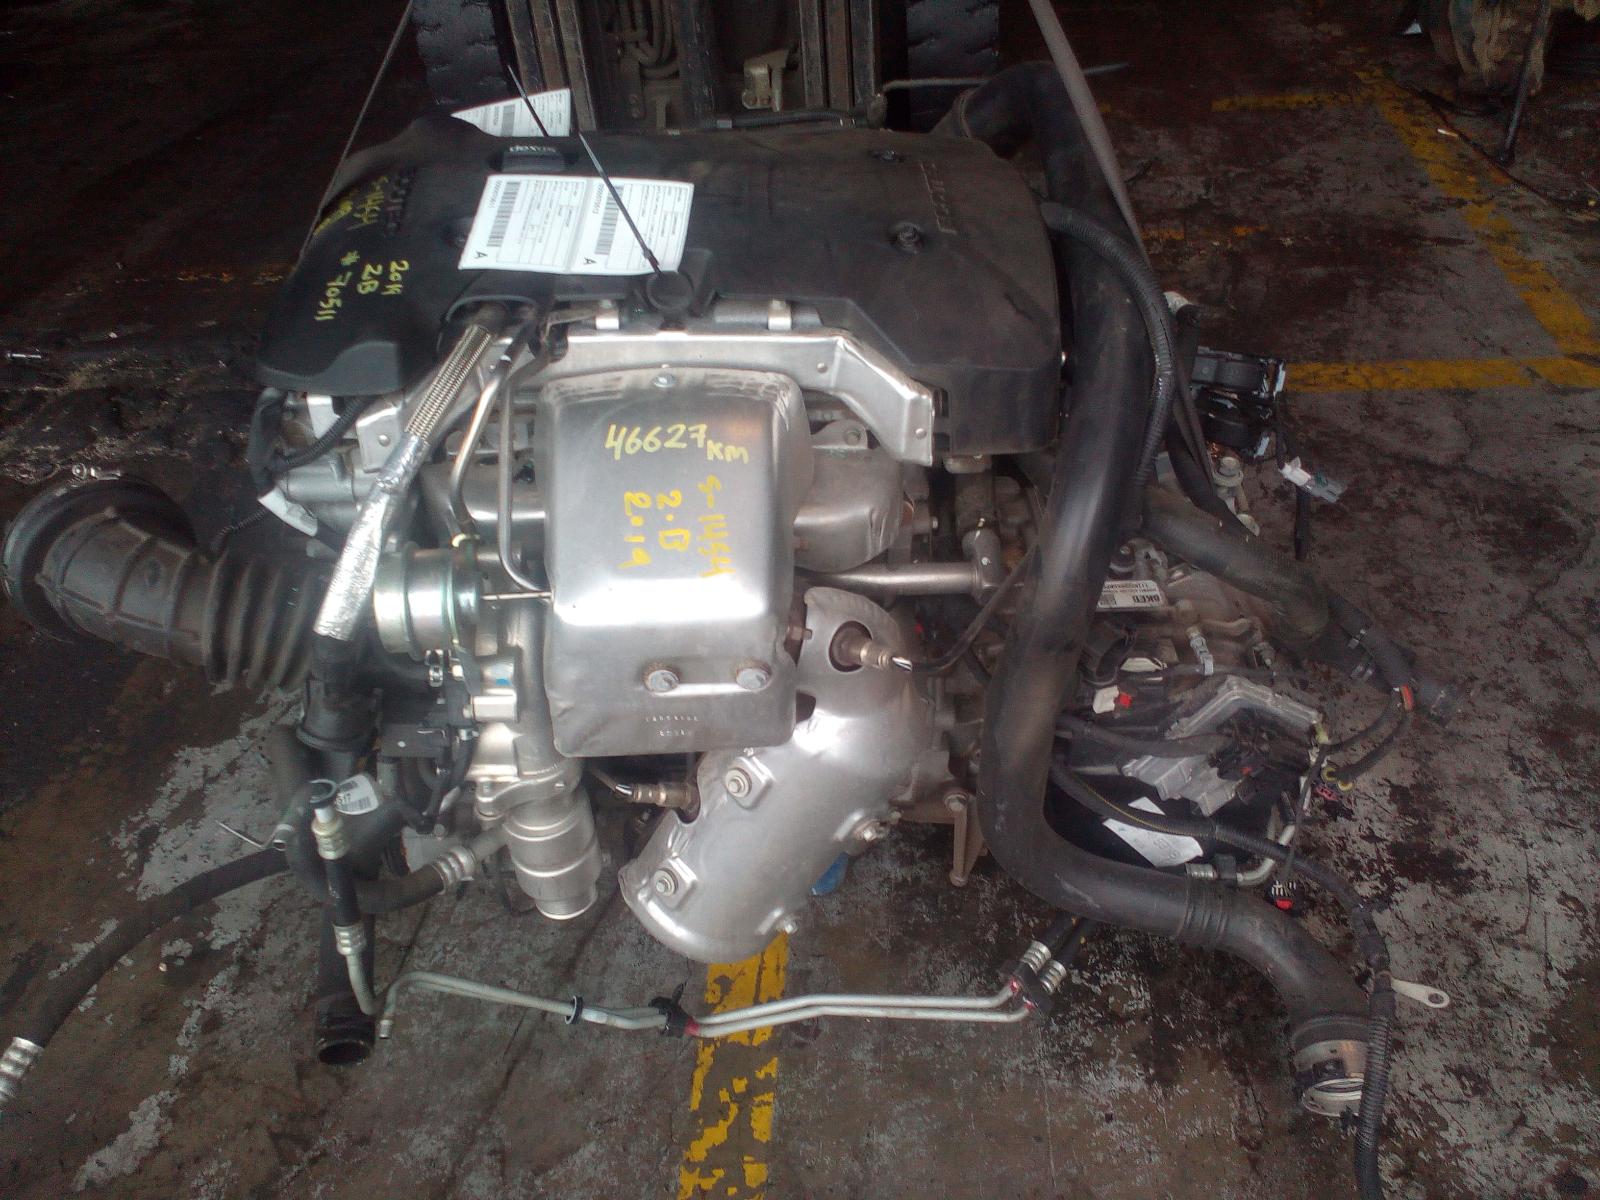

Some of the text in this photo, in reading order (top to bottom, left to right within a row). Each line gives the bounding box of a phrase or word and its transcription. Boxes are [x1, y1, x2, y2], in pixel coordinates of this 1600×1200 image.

[475, 251, 488, 260] A
[313, 271, 353, 321] 70511
[604, 423, 708, 461] 46627
